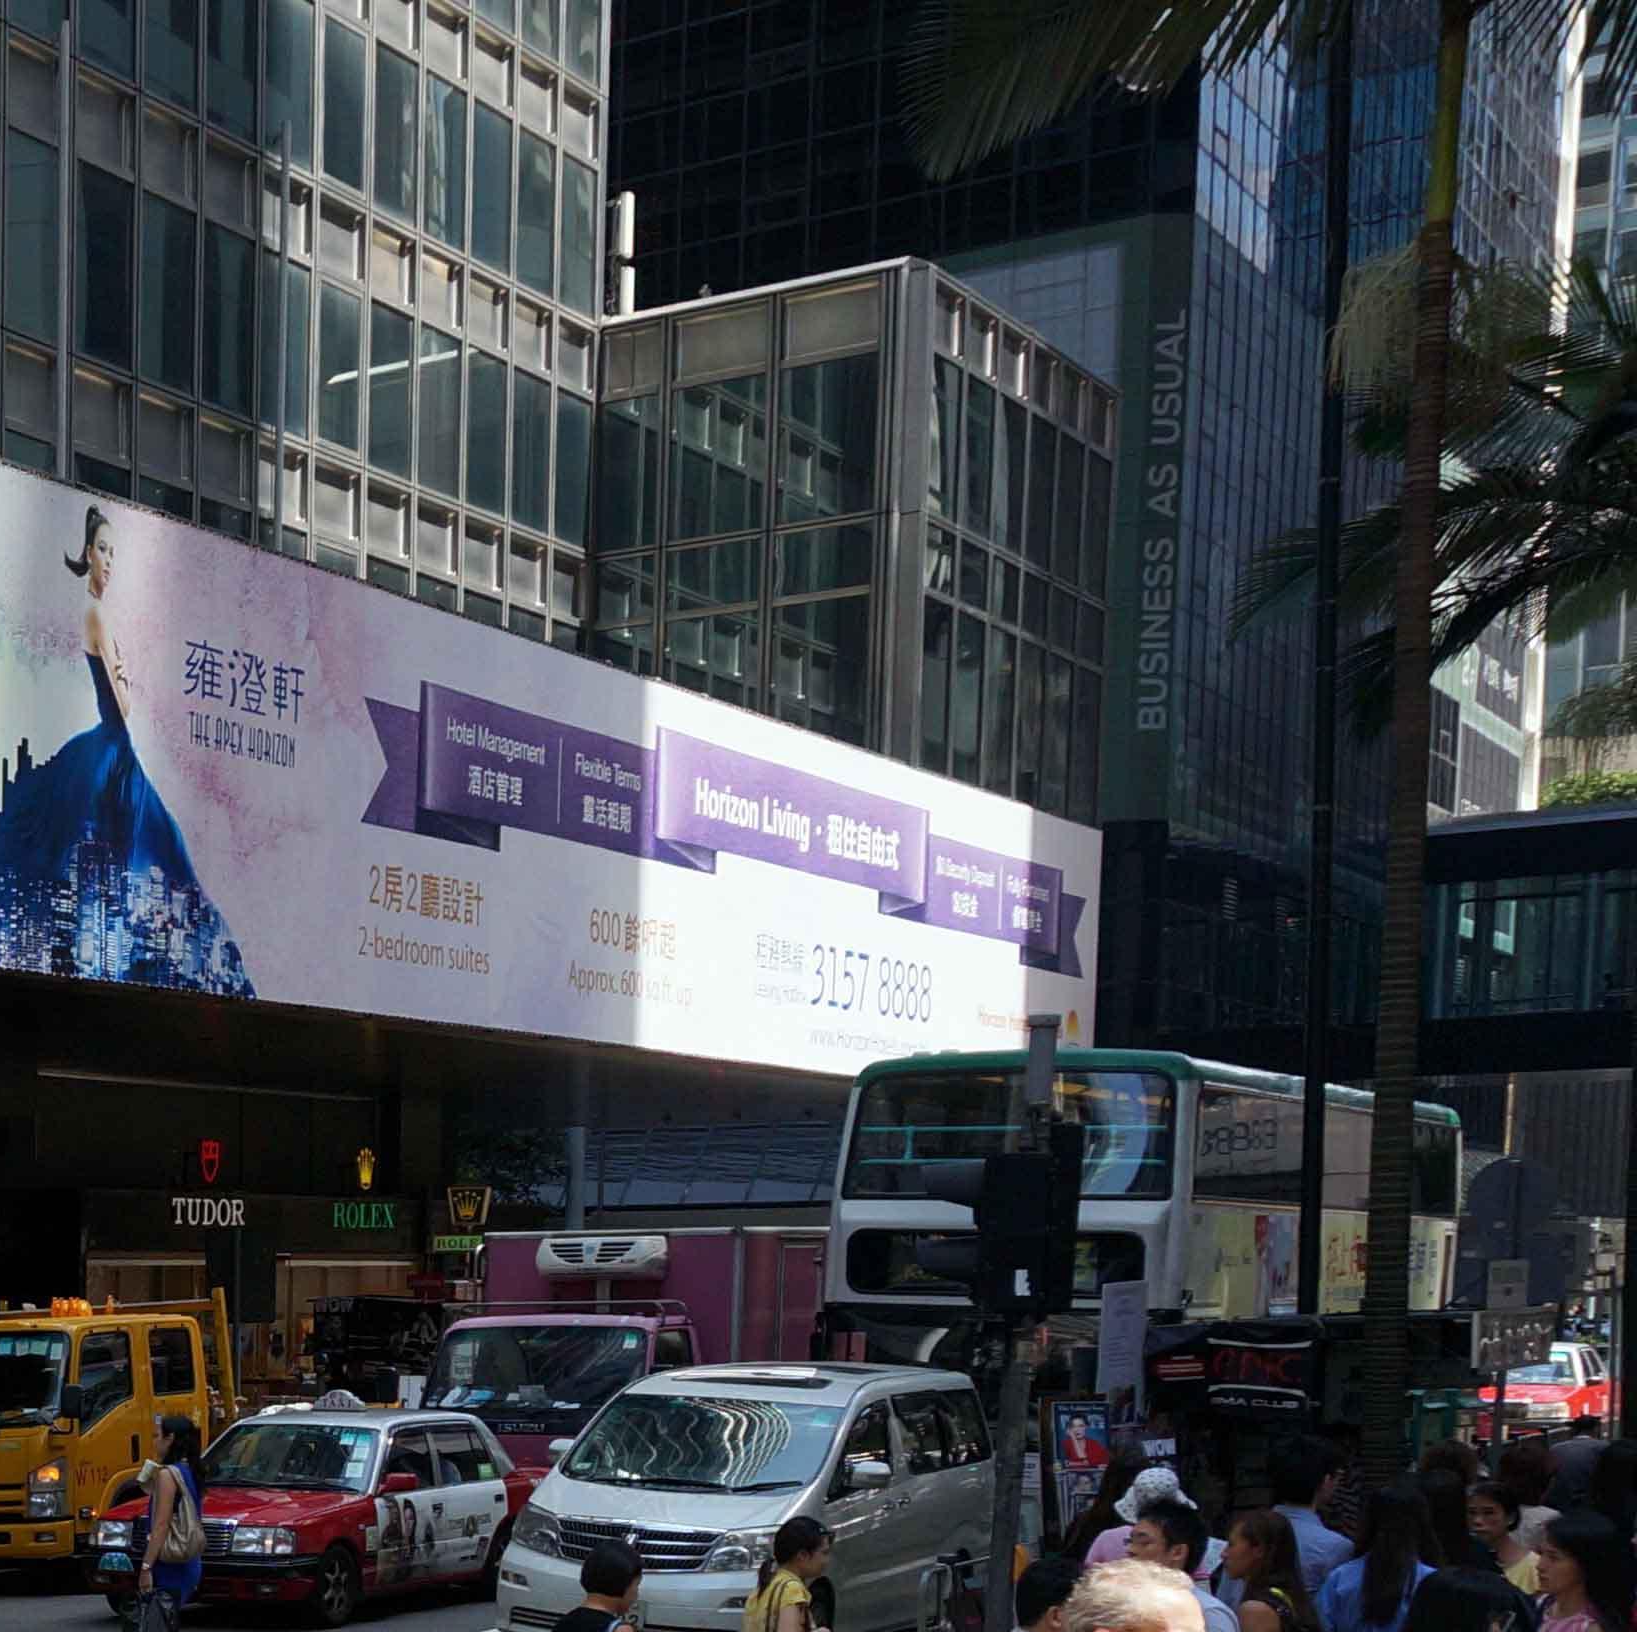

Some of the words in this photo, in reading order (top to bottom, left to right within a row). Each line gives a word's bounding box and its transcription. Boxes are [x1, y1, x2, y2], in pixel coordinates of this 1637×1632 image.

[1151, 308, 1187, 446] USUAL
[1148, 463, 1178, 518] AS
[1137, 536, 1174, 732] BUSINESS
[183, 639, 306, 724] 雍澄軒
[188, 711, 211, 748] THE
[214, 716, 244, 756] APEX
[248, 727, 297, 769] HORIZON
[446, 716, 476, 747] Hotel
[478, 726, 546, 766] Management
[467, 764, 523, 807] 酒店管理
[574, 752, 612, 784] Flexible
[613, 762, 642, 792] Terms
[694, 776, 760, 830] Horizon
[762, 795, 811, 853] Living
[368, 863, 485, 928] 2房2廳設計
[358, 925, 445, 970] 2-bedroom
[448, 943, 490, 976] suites
[568, 959, 618, 998] Approx.
[621, 968, 643, 998] 600
[810, 943, 870, 1012] 3157
[878, 956, 933, 1024] 8888
[171, 1197, 246, 1226] TUDOR
[333, 1202, 398, 1229] ROLEX
